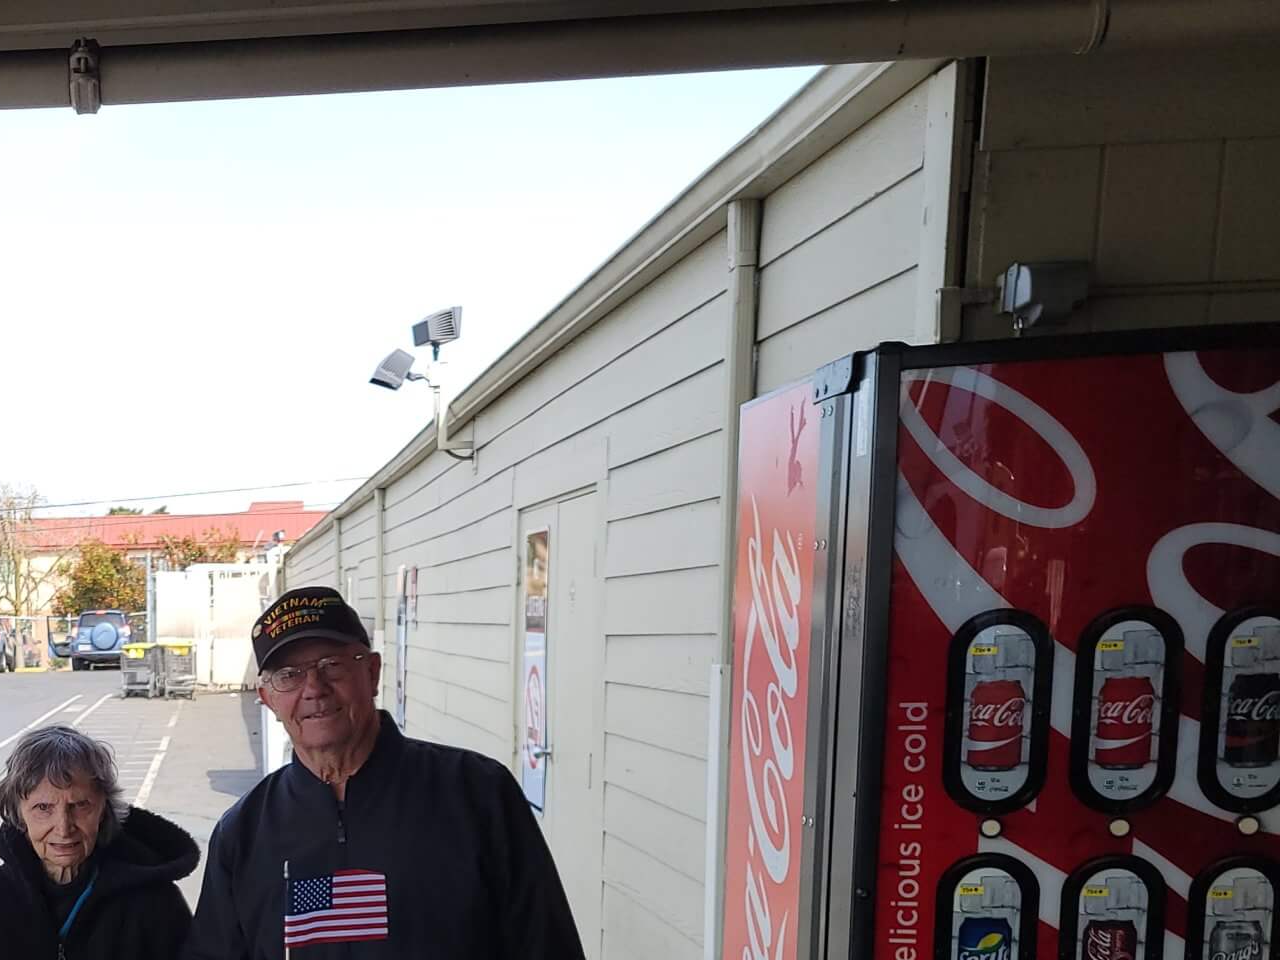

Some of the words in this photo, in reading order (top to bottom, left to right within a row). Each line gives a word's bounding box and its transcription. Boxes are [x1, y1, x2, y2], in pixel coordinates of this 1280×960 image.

[264, 598, 322, 625] VIETNAM
[270, 615, 320, 639] VETERAN
[898, 701, 929, 773] cold
[894, 784, 924, 830] ice
